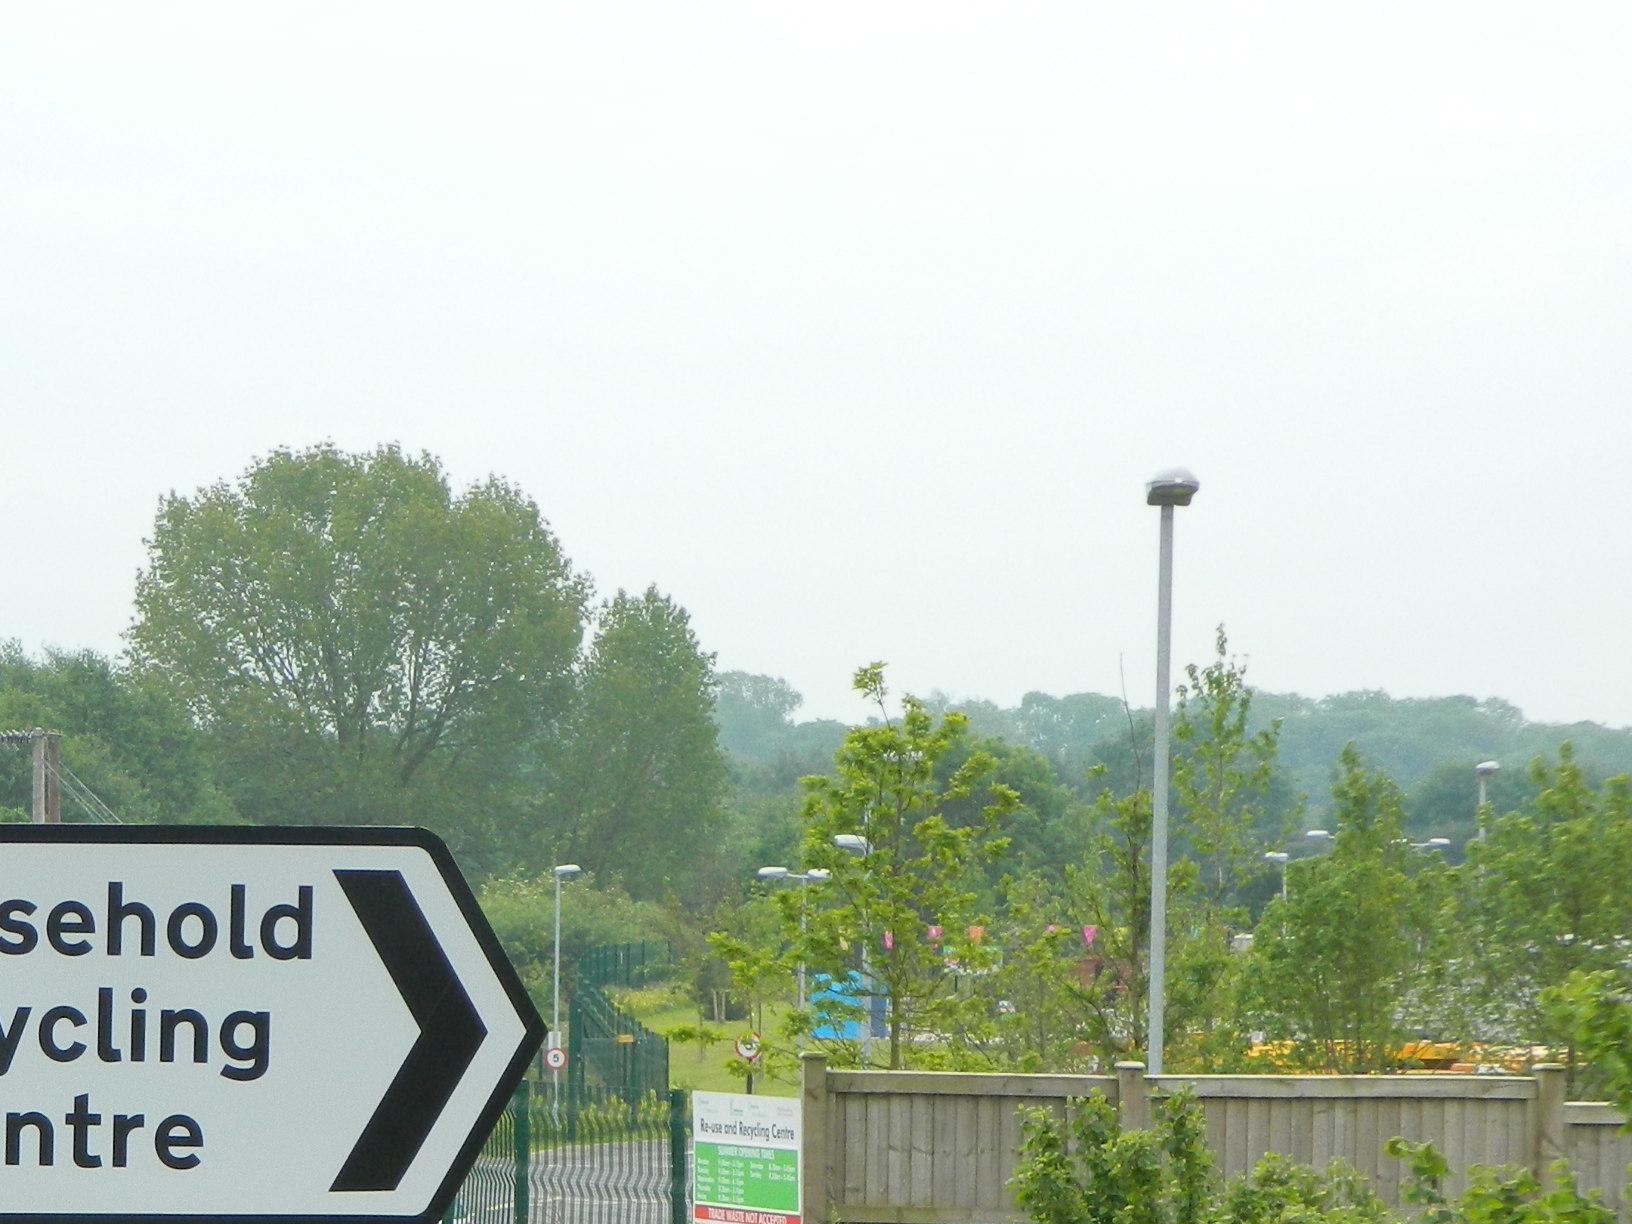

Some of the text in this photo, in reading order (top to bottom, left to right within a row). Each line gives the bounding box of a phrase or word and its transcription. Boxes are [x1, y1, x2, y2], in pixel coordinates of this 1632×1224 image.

[552, 1053, 560, 1063] 5
[700, 1118, 795, 1142] Re-use and Recycling Centre
[708, 1207, 725, 1221] TRADE
[726, 1209, 745, 1223] WASTE
[745, 1212, 758, 1224] NOT
